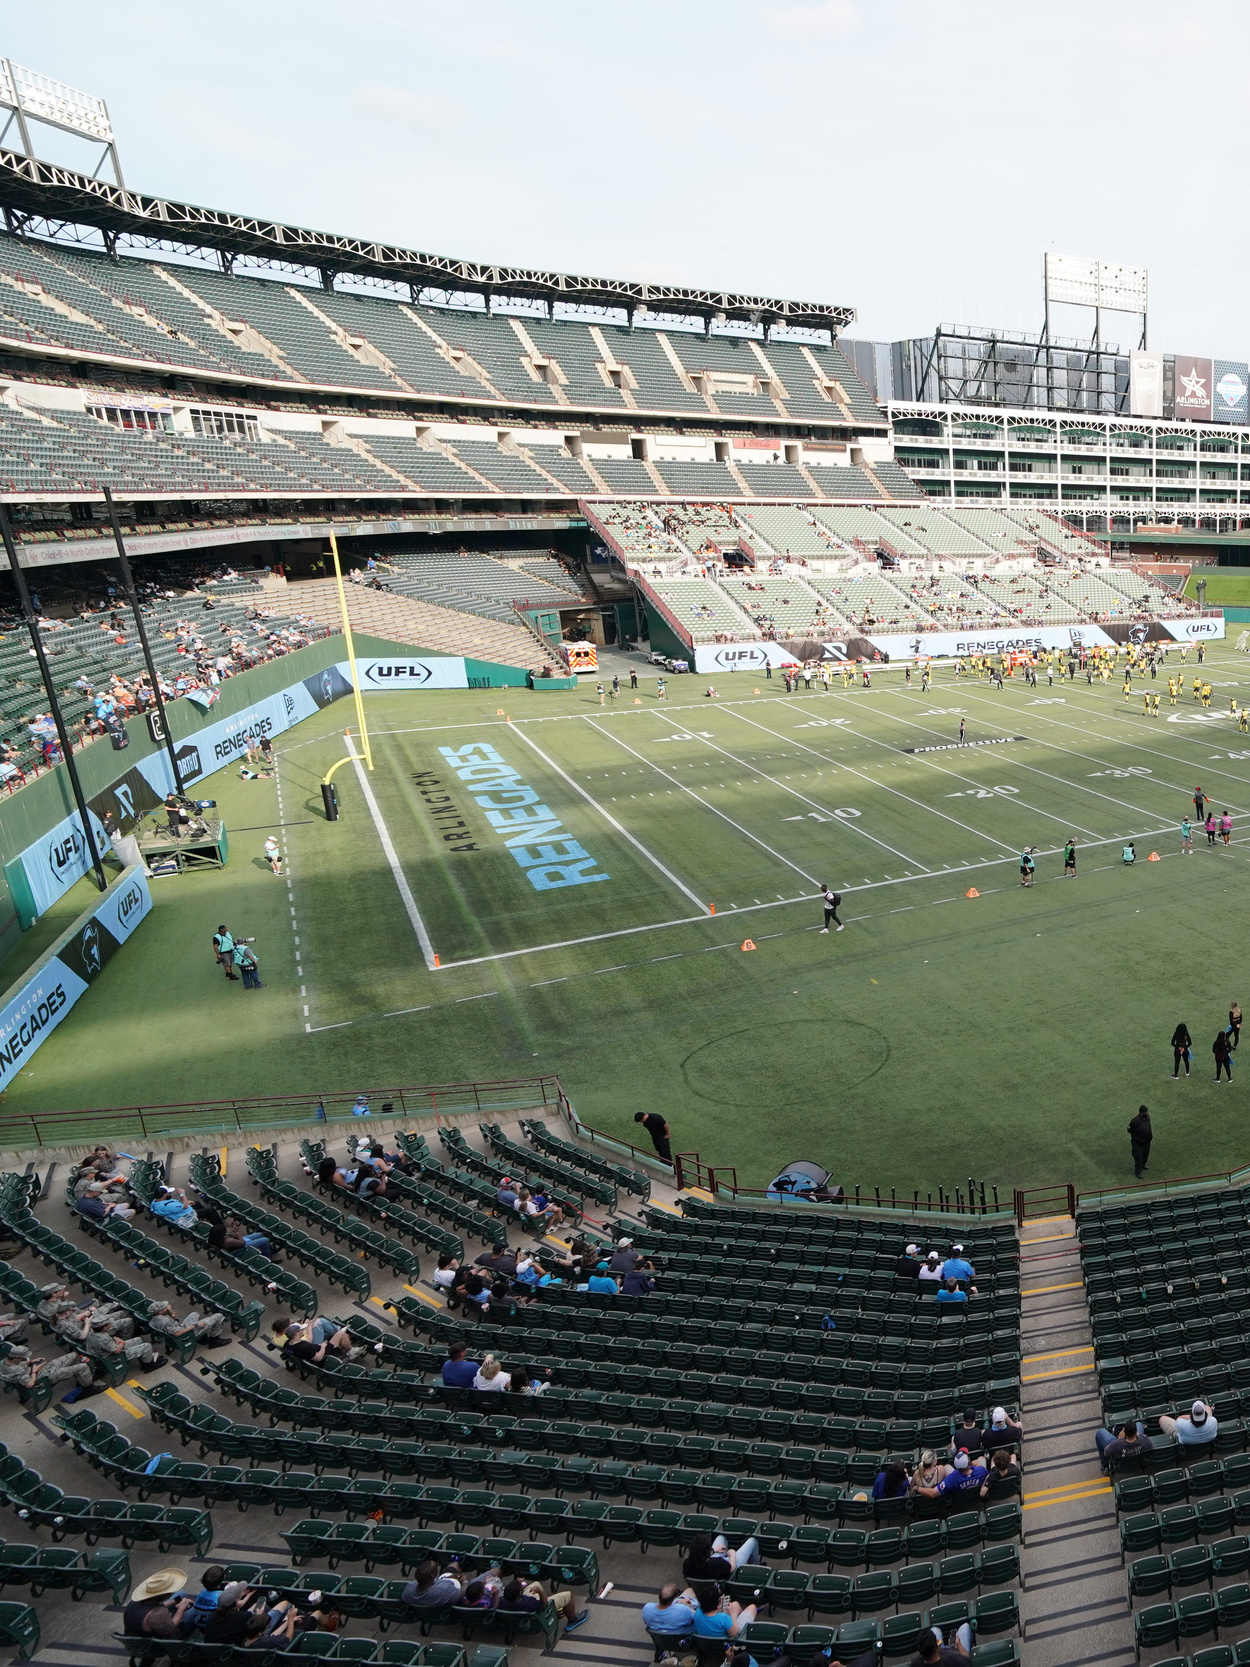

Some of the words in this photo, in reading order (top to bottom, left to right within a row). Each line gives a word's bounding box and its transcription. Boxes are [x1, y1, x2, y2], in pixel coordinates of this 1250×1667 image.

[1176, 395, 1210, 405] ARLINGTON
[1192, 624, 1214, 633] UFL
[956, 638, 1042, 652] RENEGADES
[724, 650, 762, 661] UFL
[378, 666, 421, 677] UFL
[225, 712, 259, 734] ARLINGTON
[214, 717, 273, 761] RENEGADES
[1104, 766, 1152, 778] 30
[966, 785, 1020, 799] 20
[411, 771, 480, 852] ARLINGTON
[438, 743, 611, 891] RENEGADES
[808, 807, 862, 823] 10
[54, 834, 80, 868] UFL
[120, 889, 139, 917] UFL
[0, 987, 44, 1039] RLINGTON
[0, 983, 66, 1078] NEGADES
[960, 1479, 980, 1489] SEAGER
